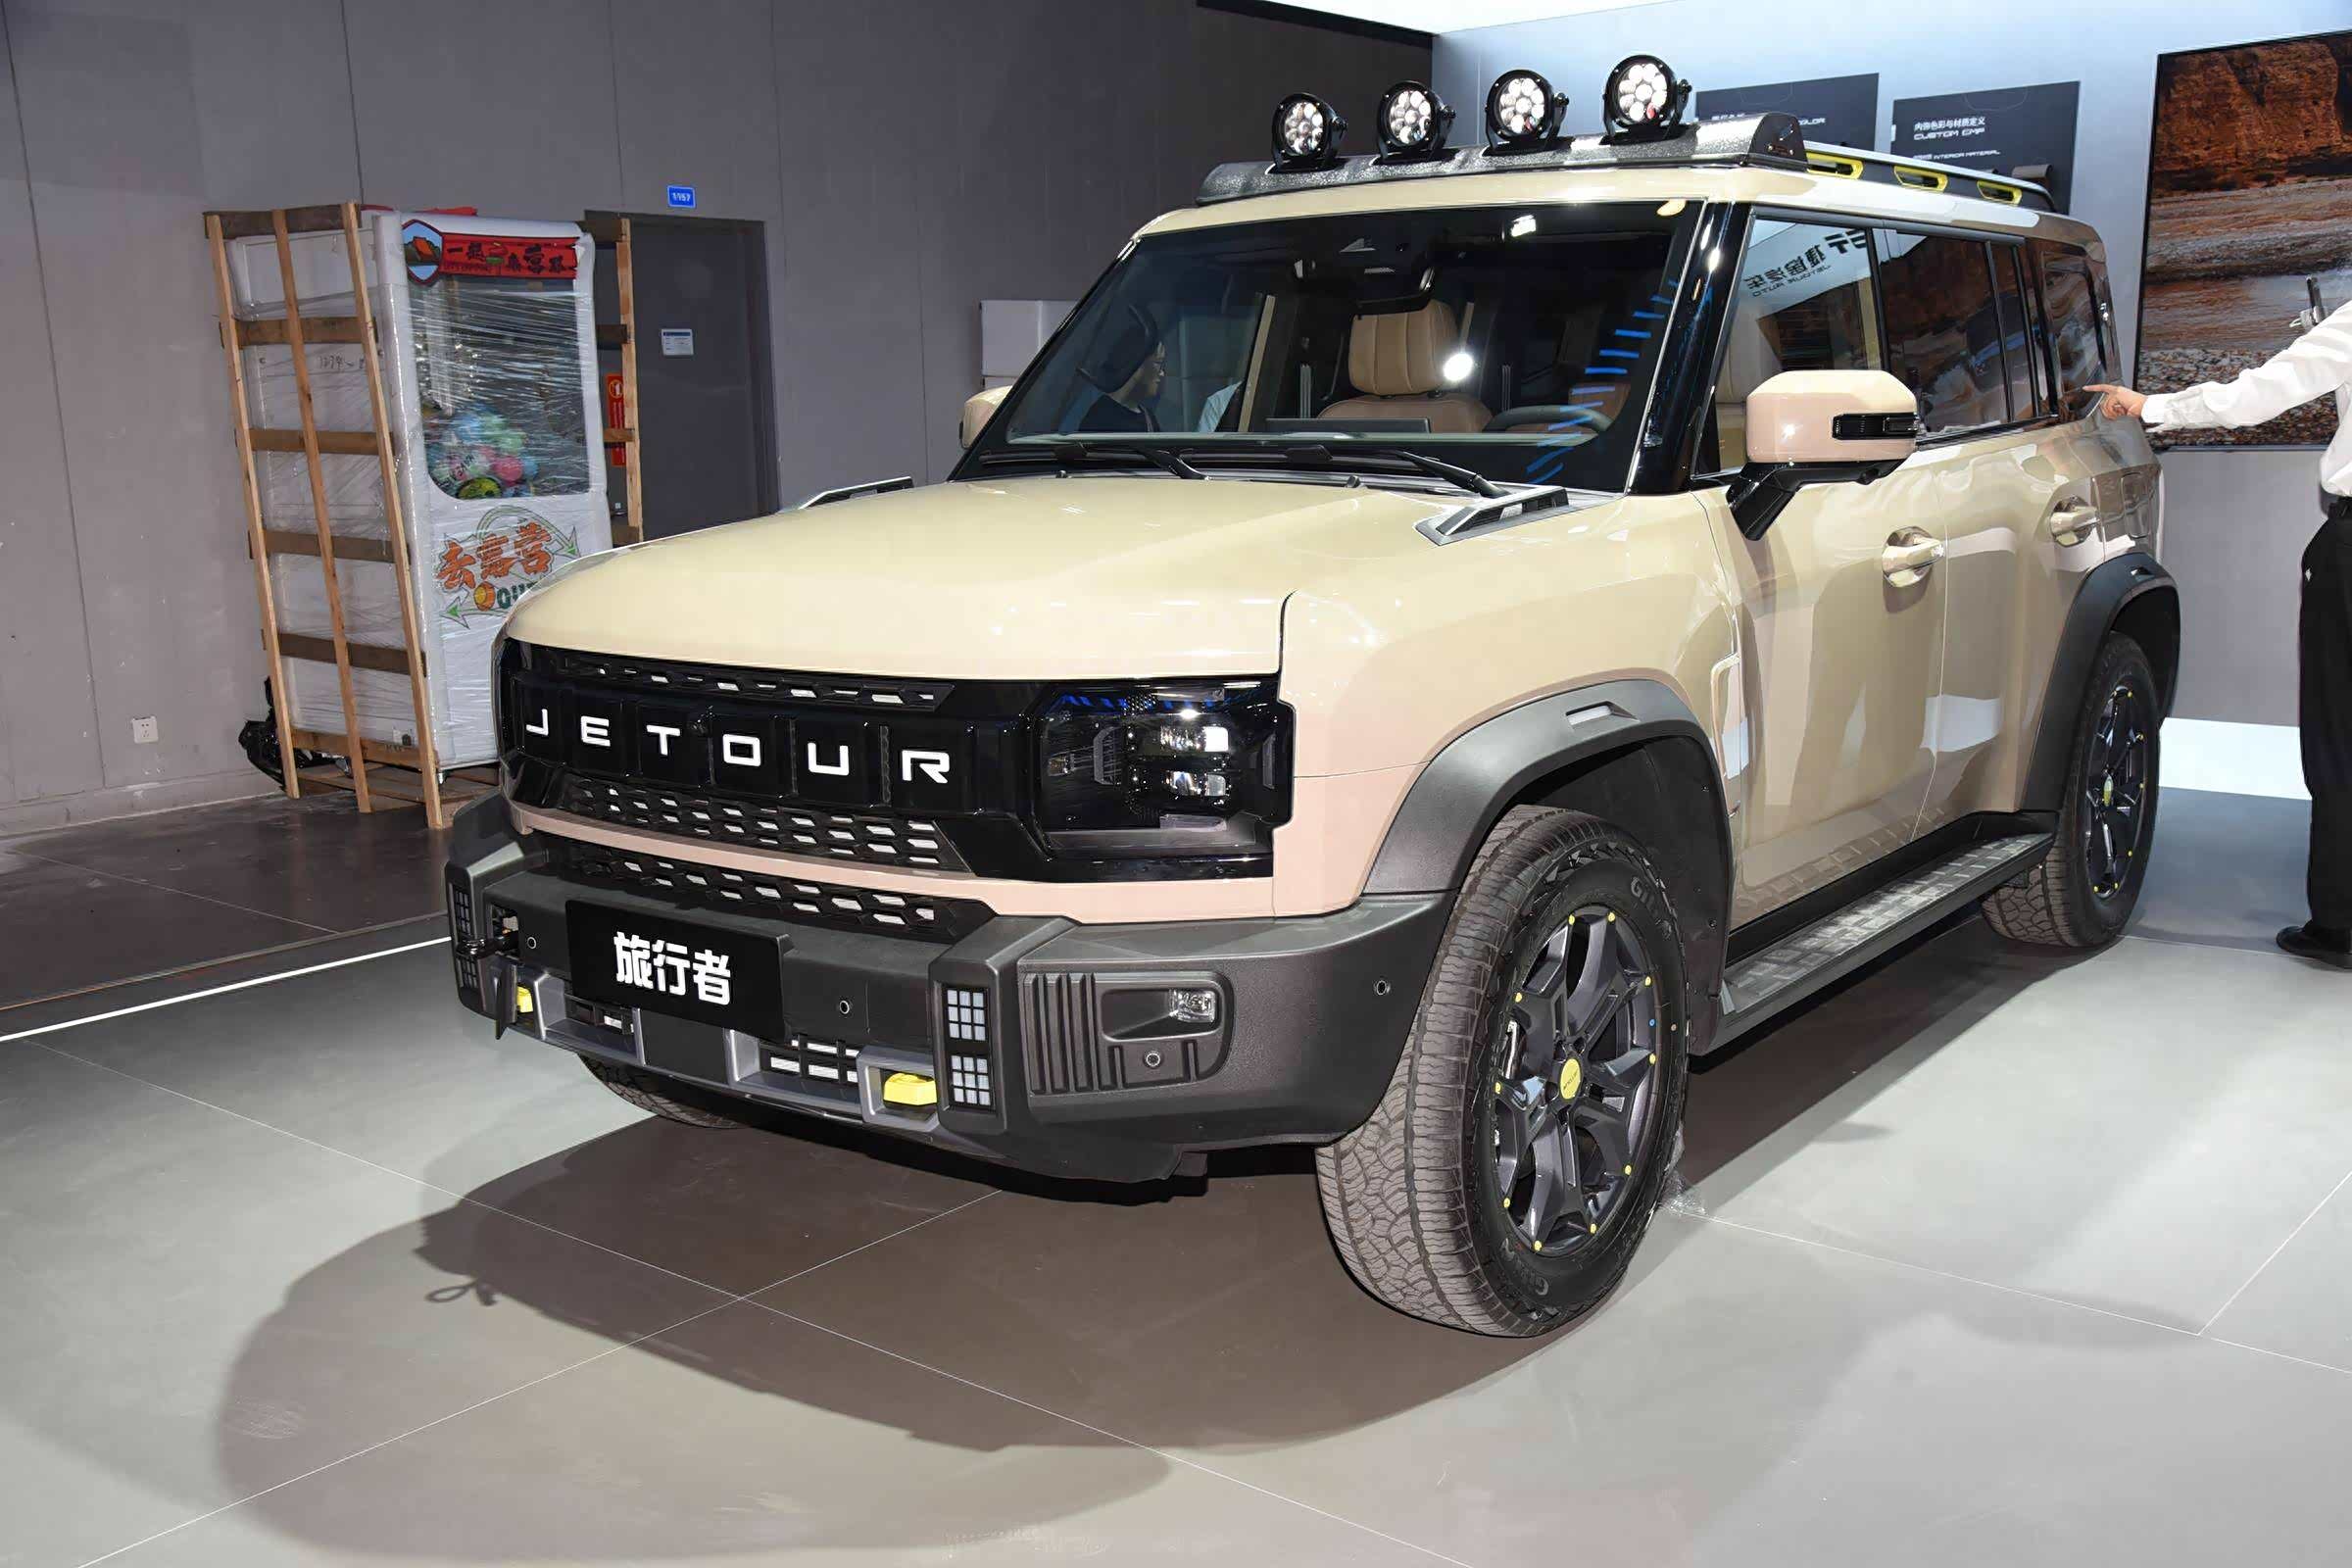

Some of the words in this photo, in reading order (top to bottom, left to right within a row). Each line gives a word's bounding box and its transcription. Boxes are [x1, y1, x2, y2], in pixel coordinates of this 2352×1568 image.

[1913, 129, 1960, 140] CUSTOM
[526, 709, 951, 784] JETOUR
[613, 931, 731, 1005] 旅行者
